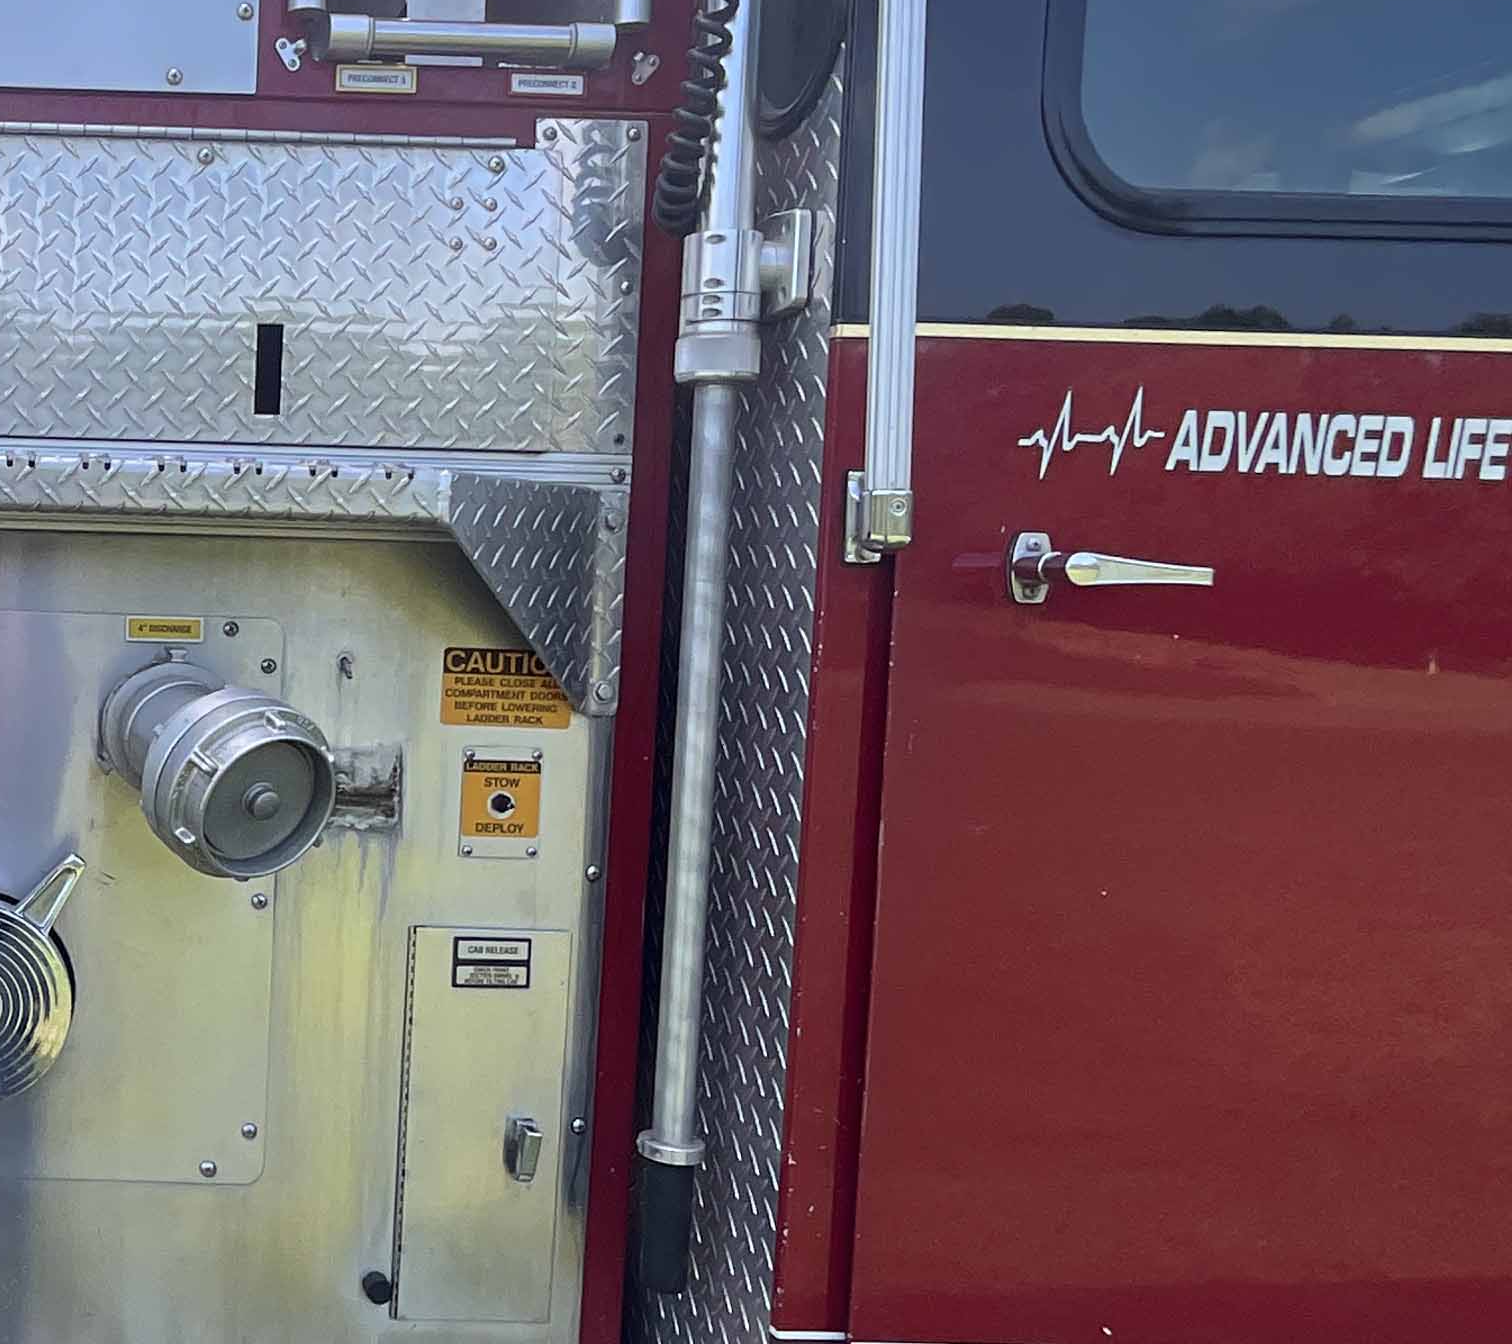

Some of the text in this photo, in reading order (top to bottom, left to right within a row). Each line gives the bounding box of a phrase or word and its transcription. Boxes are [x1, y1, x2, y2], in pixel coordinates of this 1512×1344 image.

[1165, 410, 1511, 481] ADVANCED LIFE
[445, 650, 550, 674] CAUTIO
[454, 676, 494, 687] PLEASE
[499, 677, 536, 688] CLOSE
[445, 688, 526, 700] COMPARTMENT
[454, 701, 558, 713] BEFORE LOWERING
[466, 714, 543, 725] LADDER RACK
[466, 761, 539, 773] LADDER RACK
[483, 777, 520, 788] STOW
[475, 822, 524, 834] DEPLOY
[467, 946, 519, 955] CAB RELEASE
